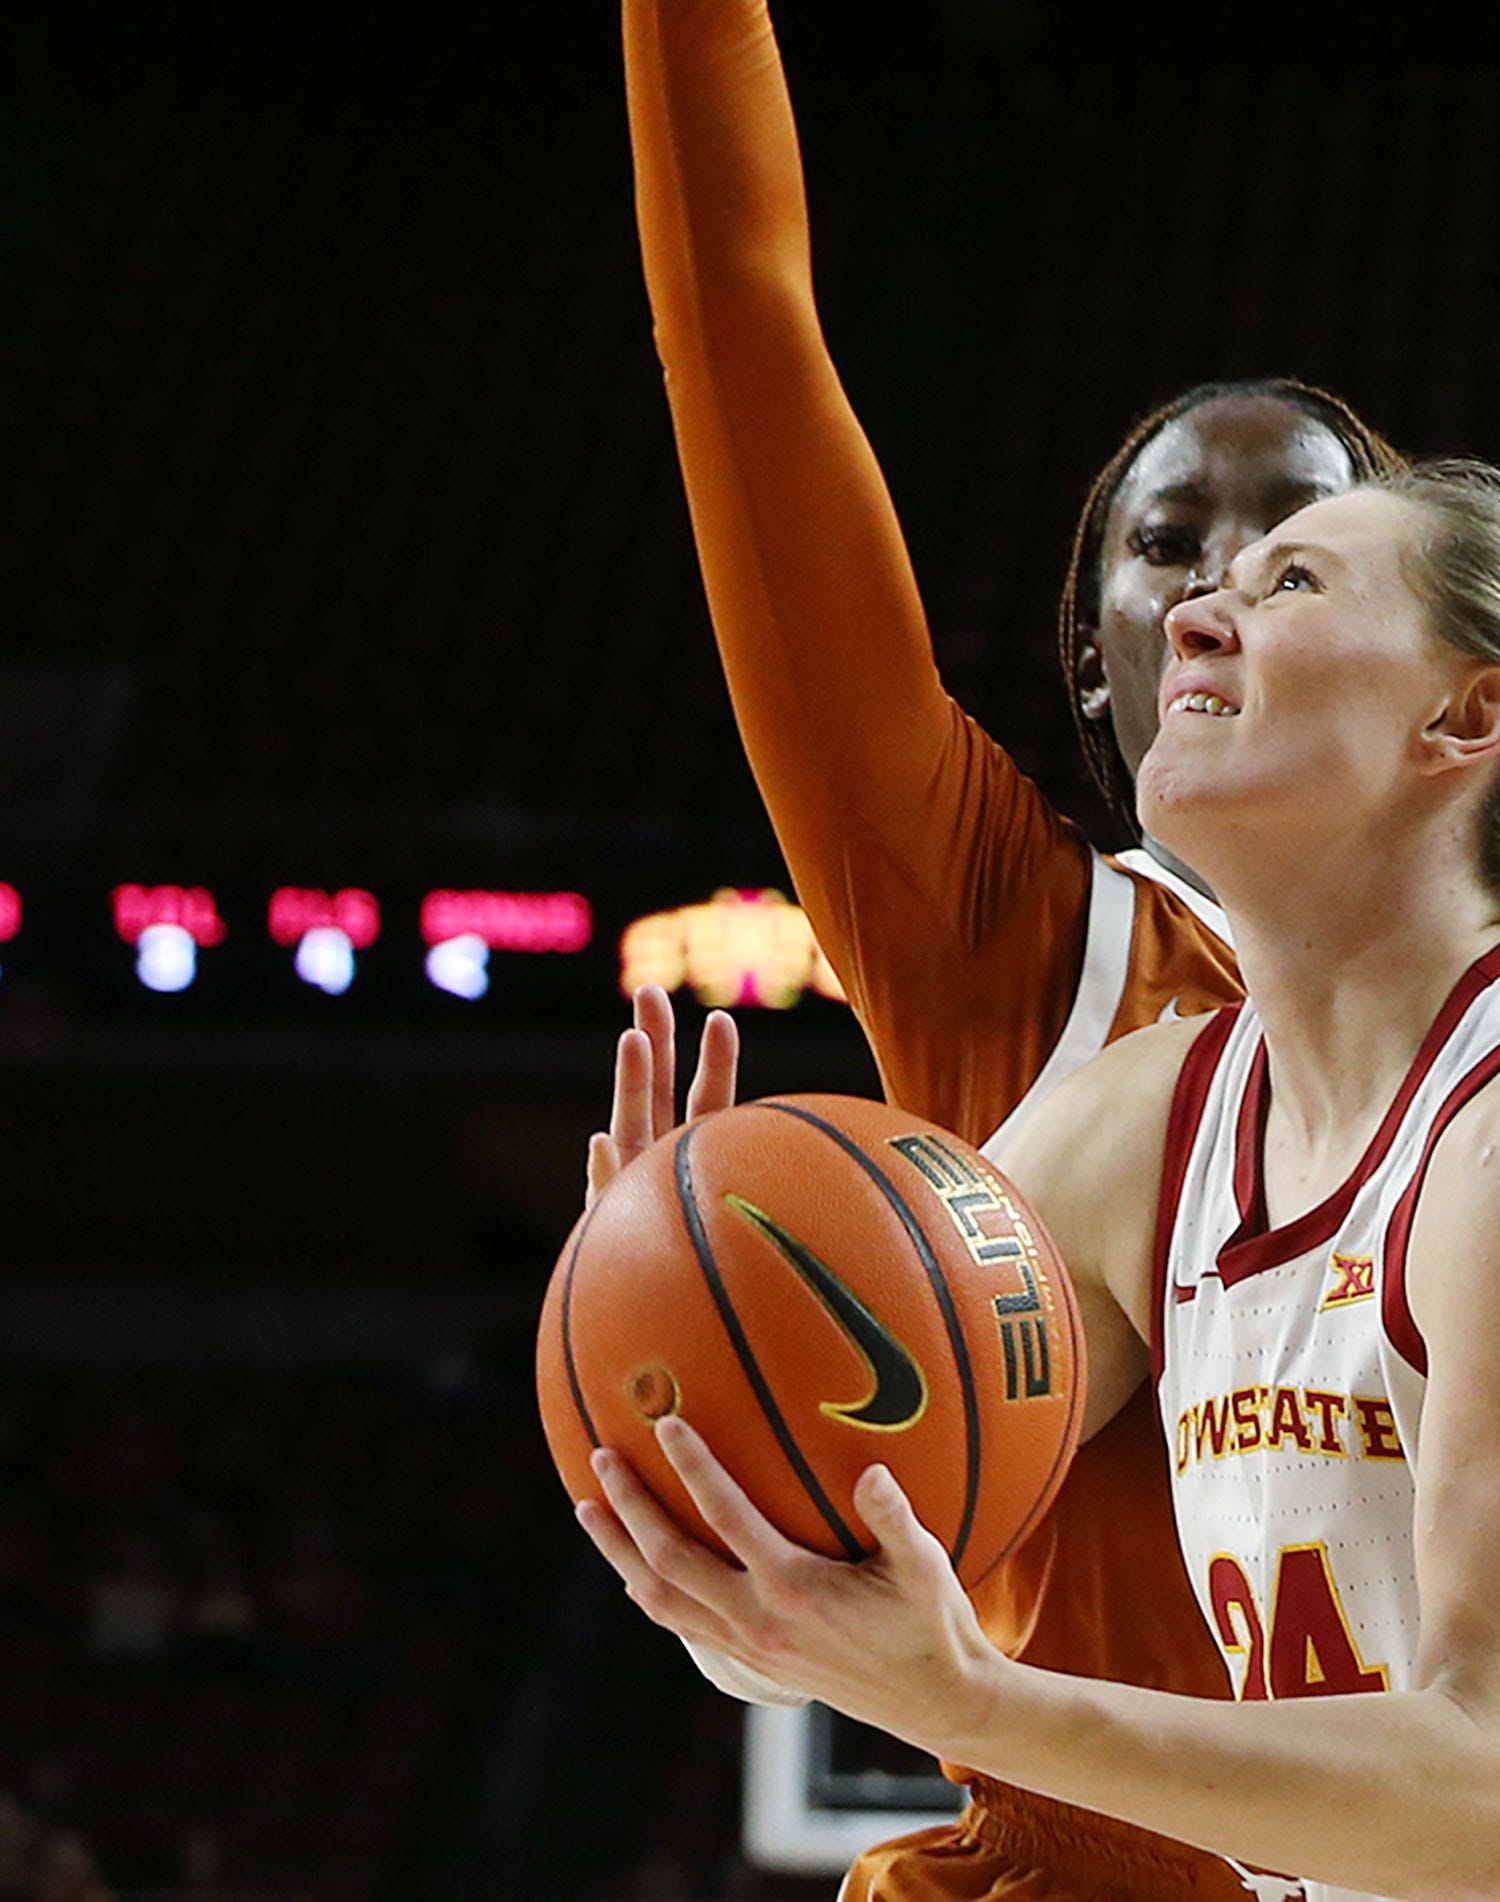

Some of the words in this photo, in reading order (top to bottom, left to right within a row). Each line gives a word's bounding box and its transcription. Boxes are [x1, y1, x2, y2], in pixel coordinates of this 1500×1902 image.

[885, 1133, 1051, 1401] ELITE
[1231, 1384, 1406, 1464] SATE
[1208, 1541, 1391, 1702] 24
